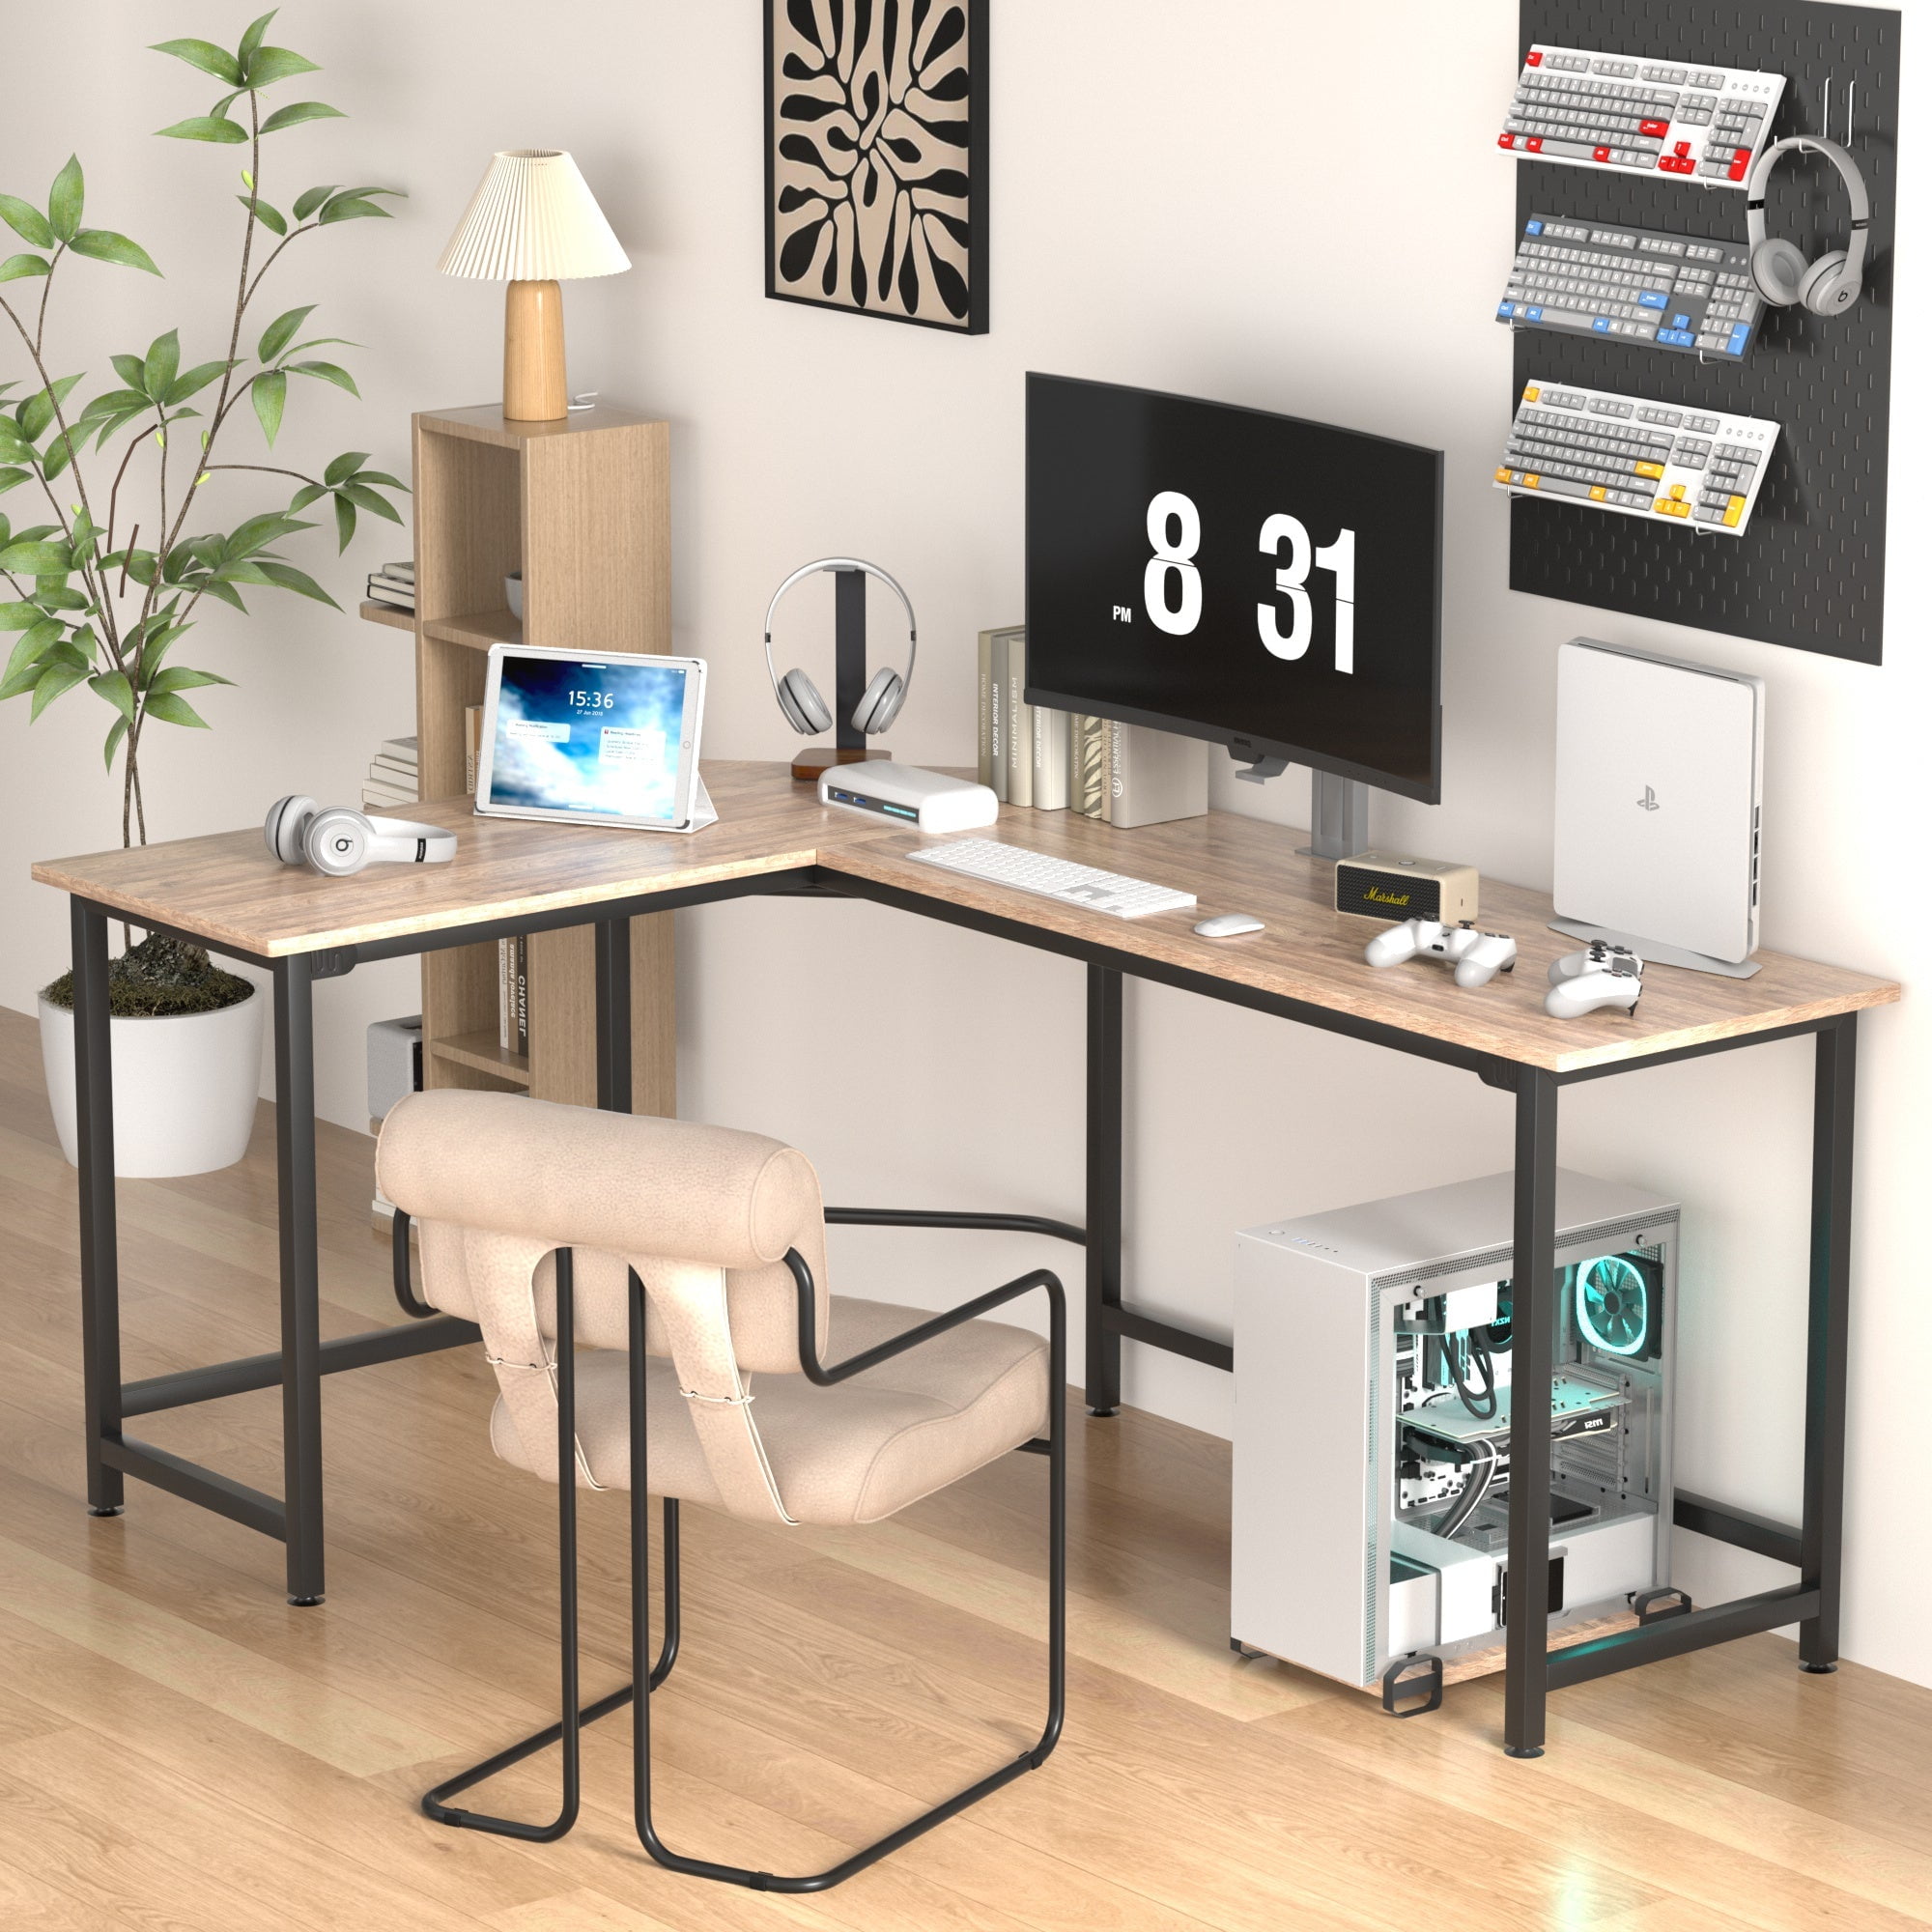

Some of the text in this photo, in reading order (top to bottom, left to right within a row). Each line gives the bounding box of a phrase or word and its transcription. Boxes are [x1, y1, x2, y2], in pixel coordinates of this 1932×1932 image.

[1113, 491, 1355, 675] PM 8 31
[569, 691, 613, 708] 15:36
[1364, 887, 1409, 906] Marshall
